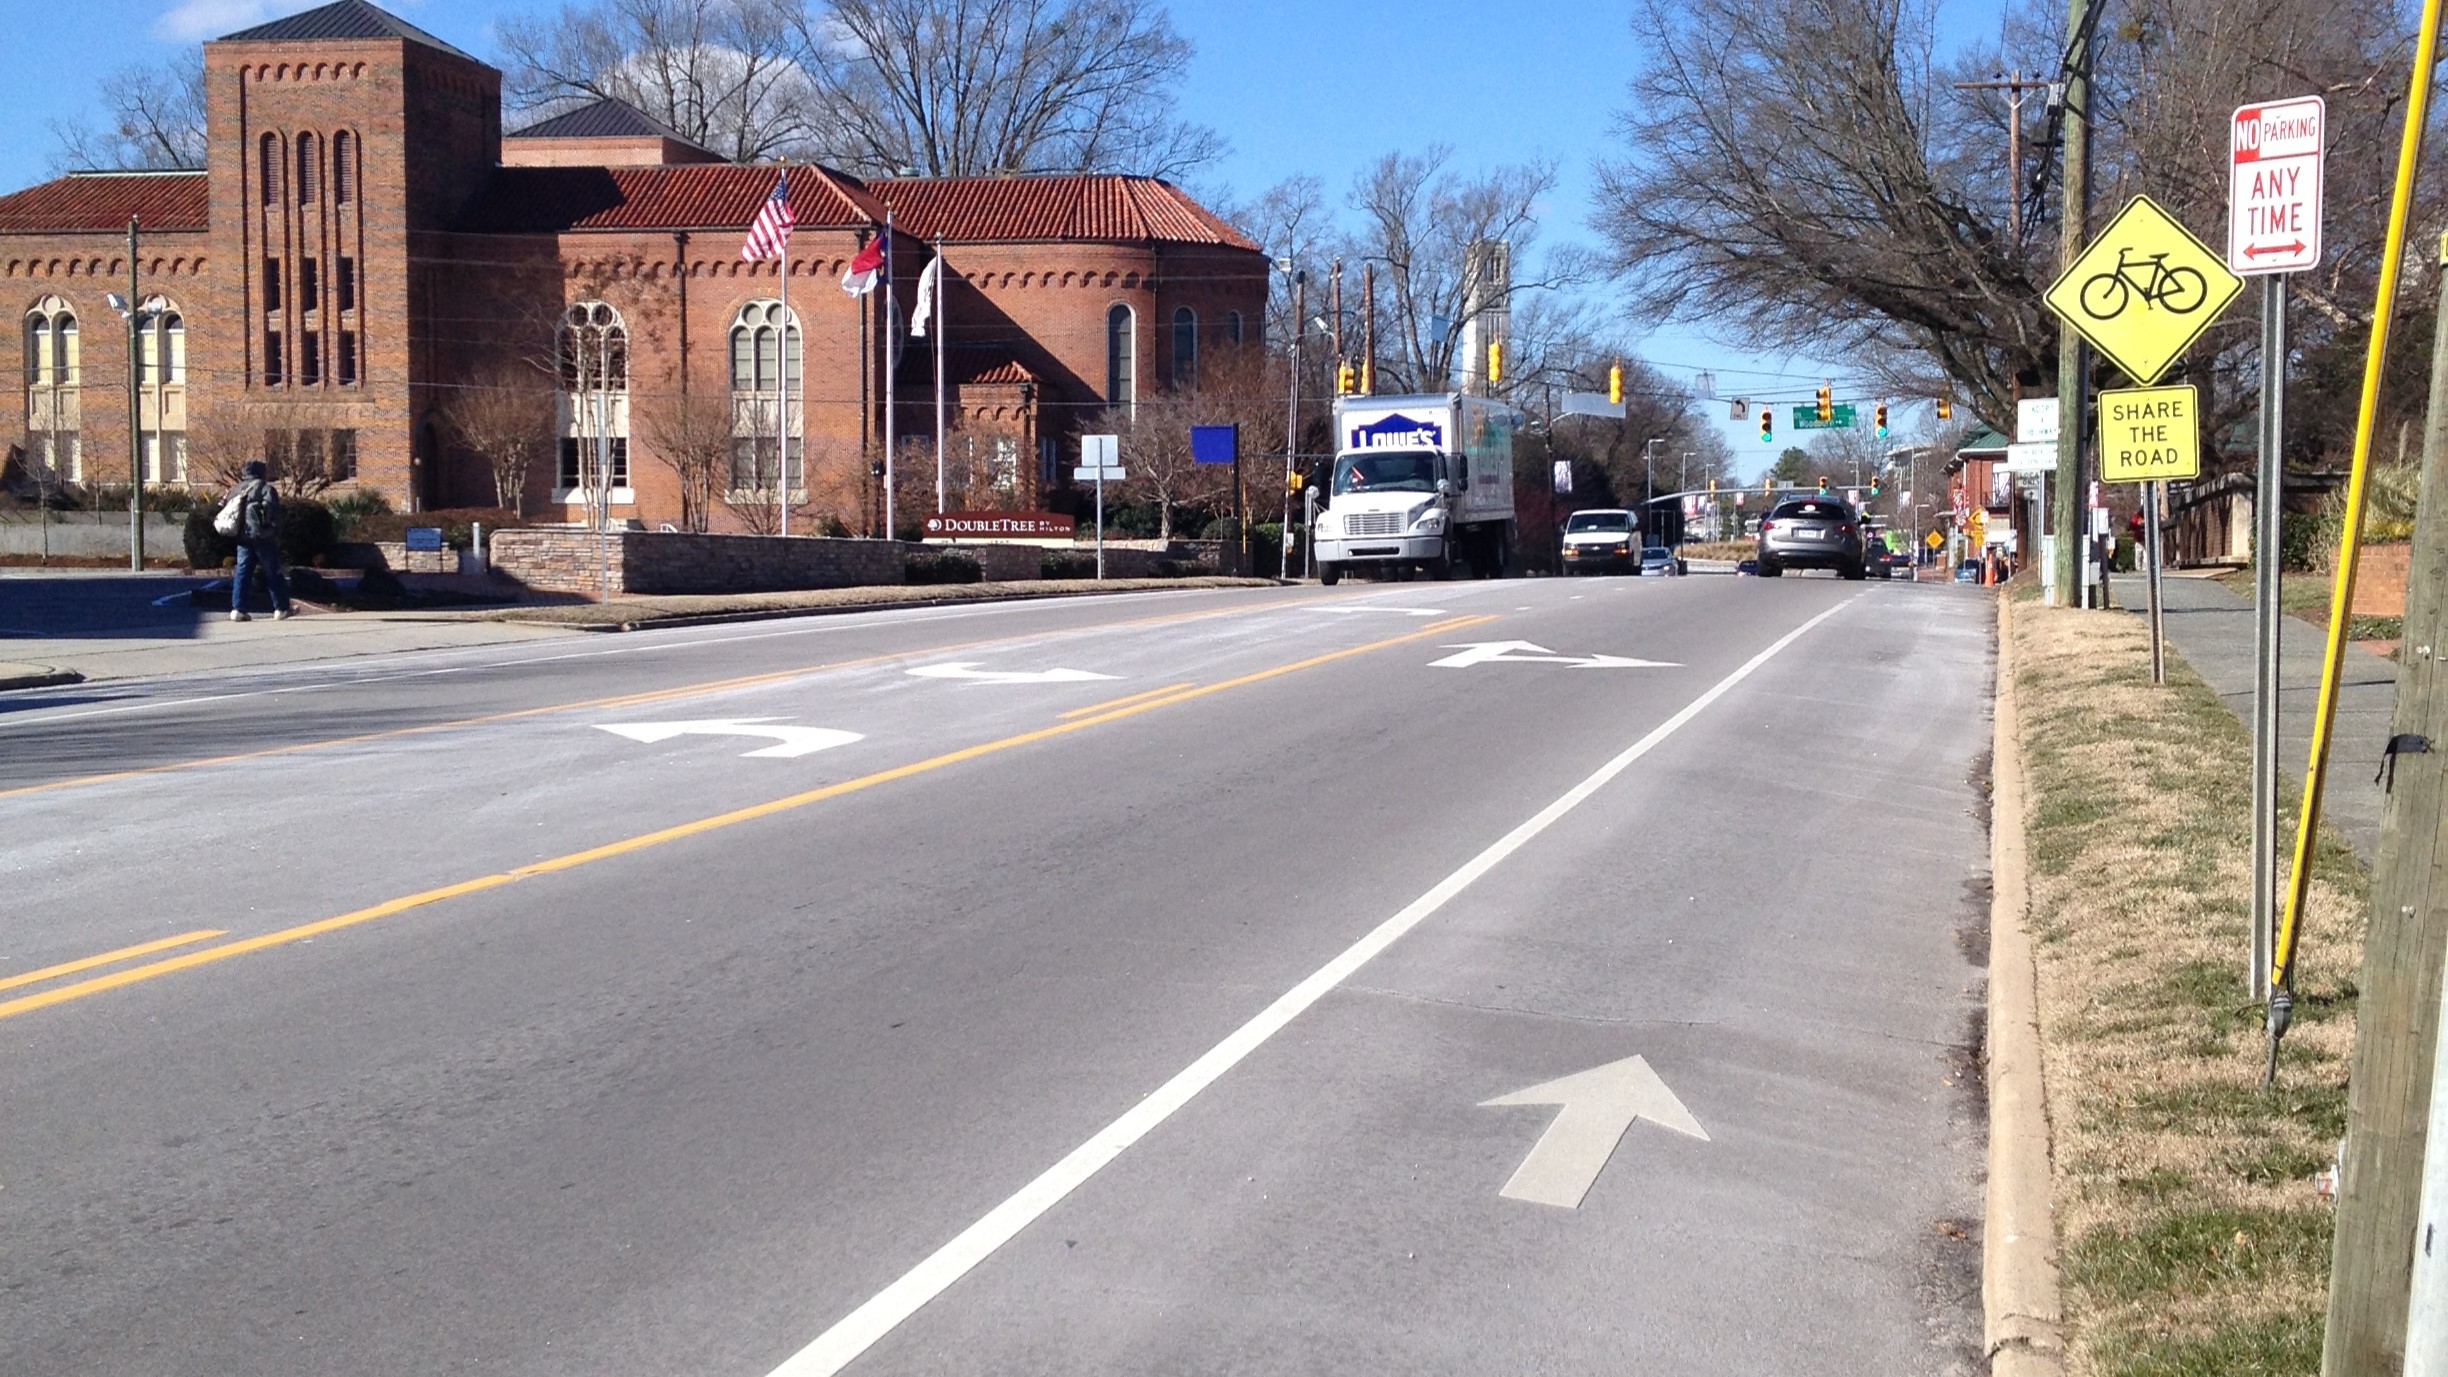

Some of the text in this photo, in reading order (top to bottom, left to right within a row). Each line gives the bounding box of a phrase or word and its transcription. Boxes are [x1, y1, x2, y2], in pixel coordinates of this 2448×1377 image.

[2236, 116, 2316, 152] NO PARKING
[2251, 166, 2301, 201] ANY
[2247, 202, 2303, 236] TIME
[2113, 400, 2183, 421] SHARE
[1359, 428, 1435, 449] LOWE'S
[2129, 425, 2168, 443] THE
[2121, 448, 2178, 467] ROAD
